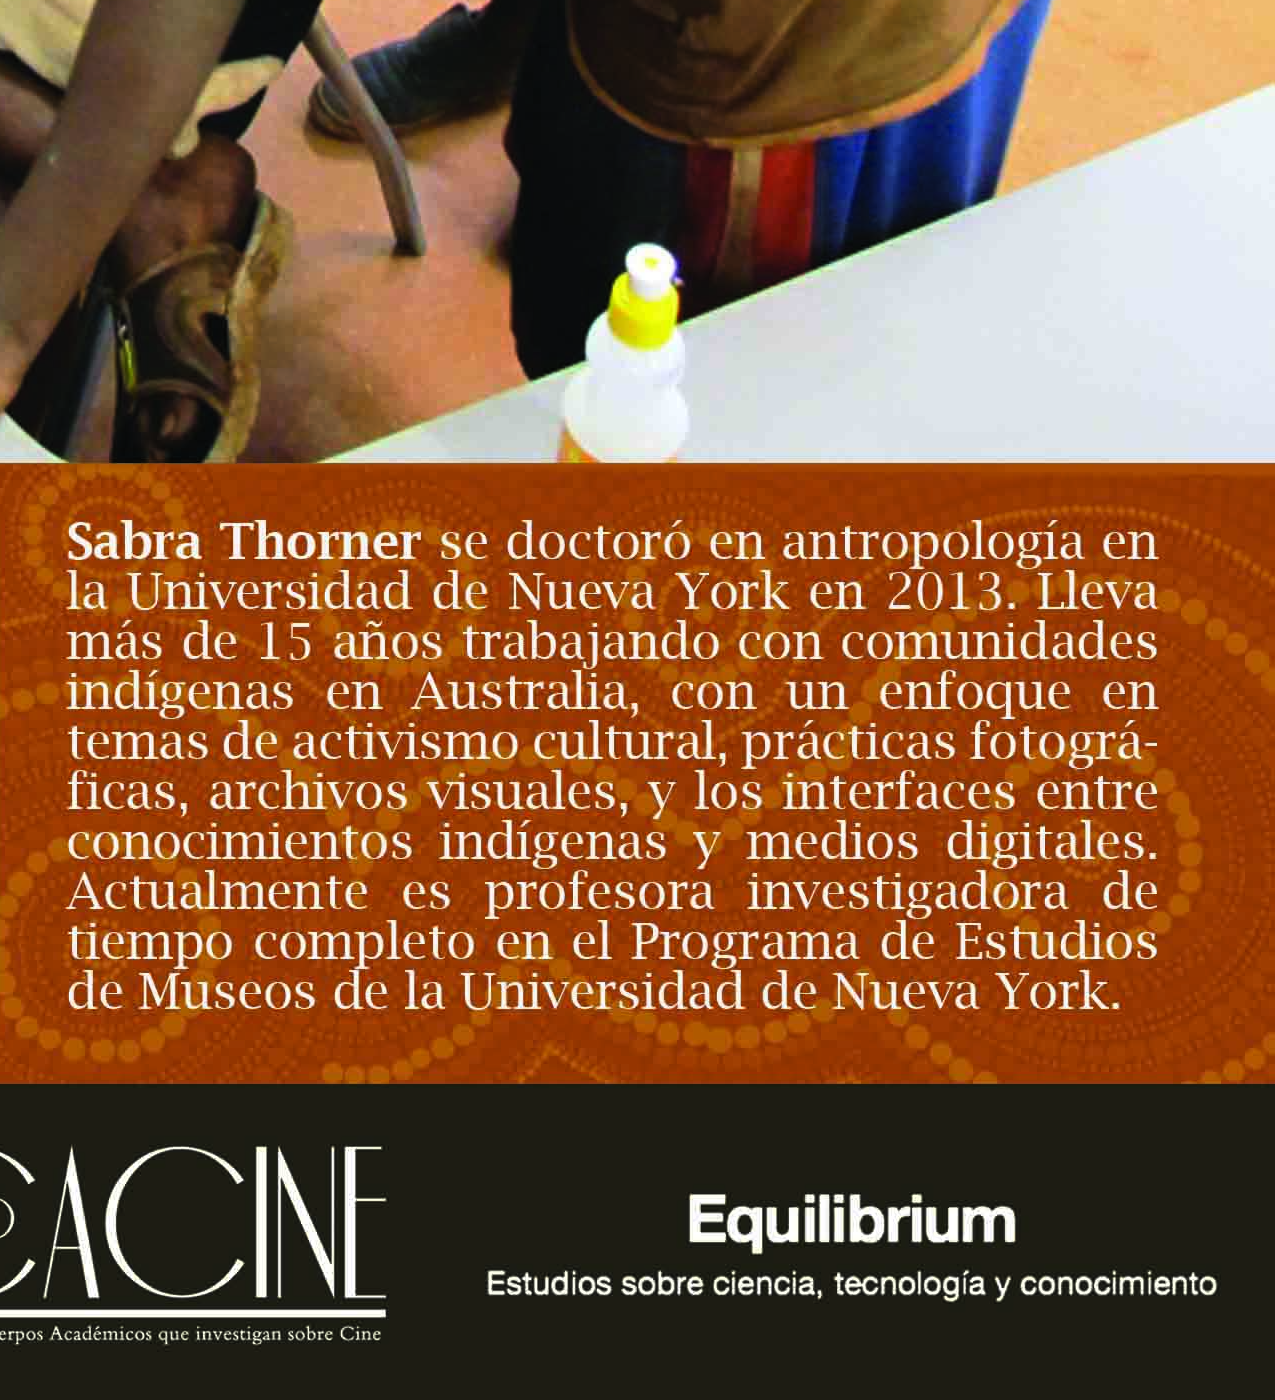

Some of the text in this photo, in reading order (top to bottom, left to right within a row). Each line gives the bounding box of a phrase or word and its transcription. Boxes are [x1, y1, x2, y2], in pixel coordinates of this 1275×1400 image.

[67, 518, 1160, 571] Sabra Thorner se doctoró en antropología en
[67, 718, 1159, 771] temas de activismo cultural, prácticas fotográ-
[67, 818, 1158, 871] conocimientos indígenas y medios digitales.
[67, 967, 1121, 1013] de Museos de la Universidad de Nueva York.
[688, 1193, 1016, 1255] Equilibrium
[487, 1269, 1218, 1303] Estudios sobre ciencia, tecnología y conocimiento
[49, 1325, 152, 1341] Académicos
[158, 1330, 190, 1345] que
[196, 1329, 282, 1345] investigan
[287, 1325, 334, 1342] sobre
[340, 1326, 382, 1342] Cine
